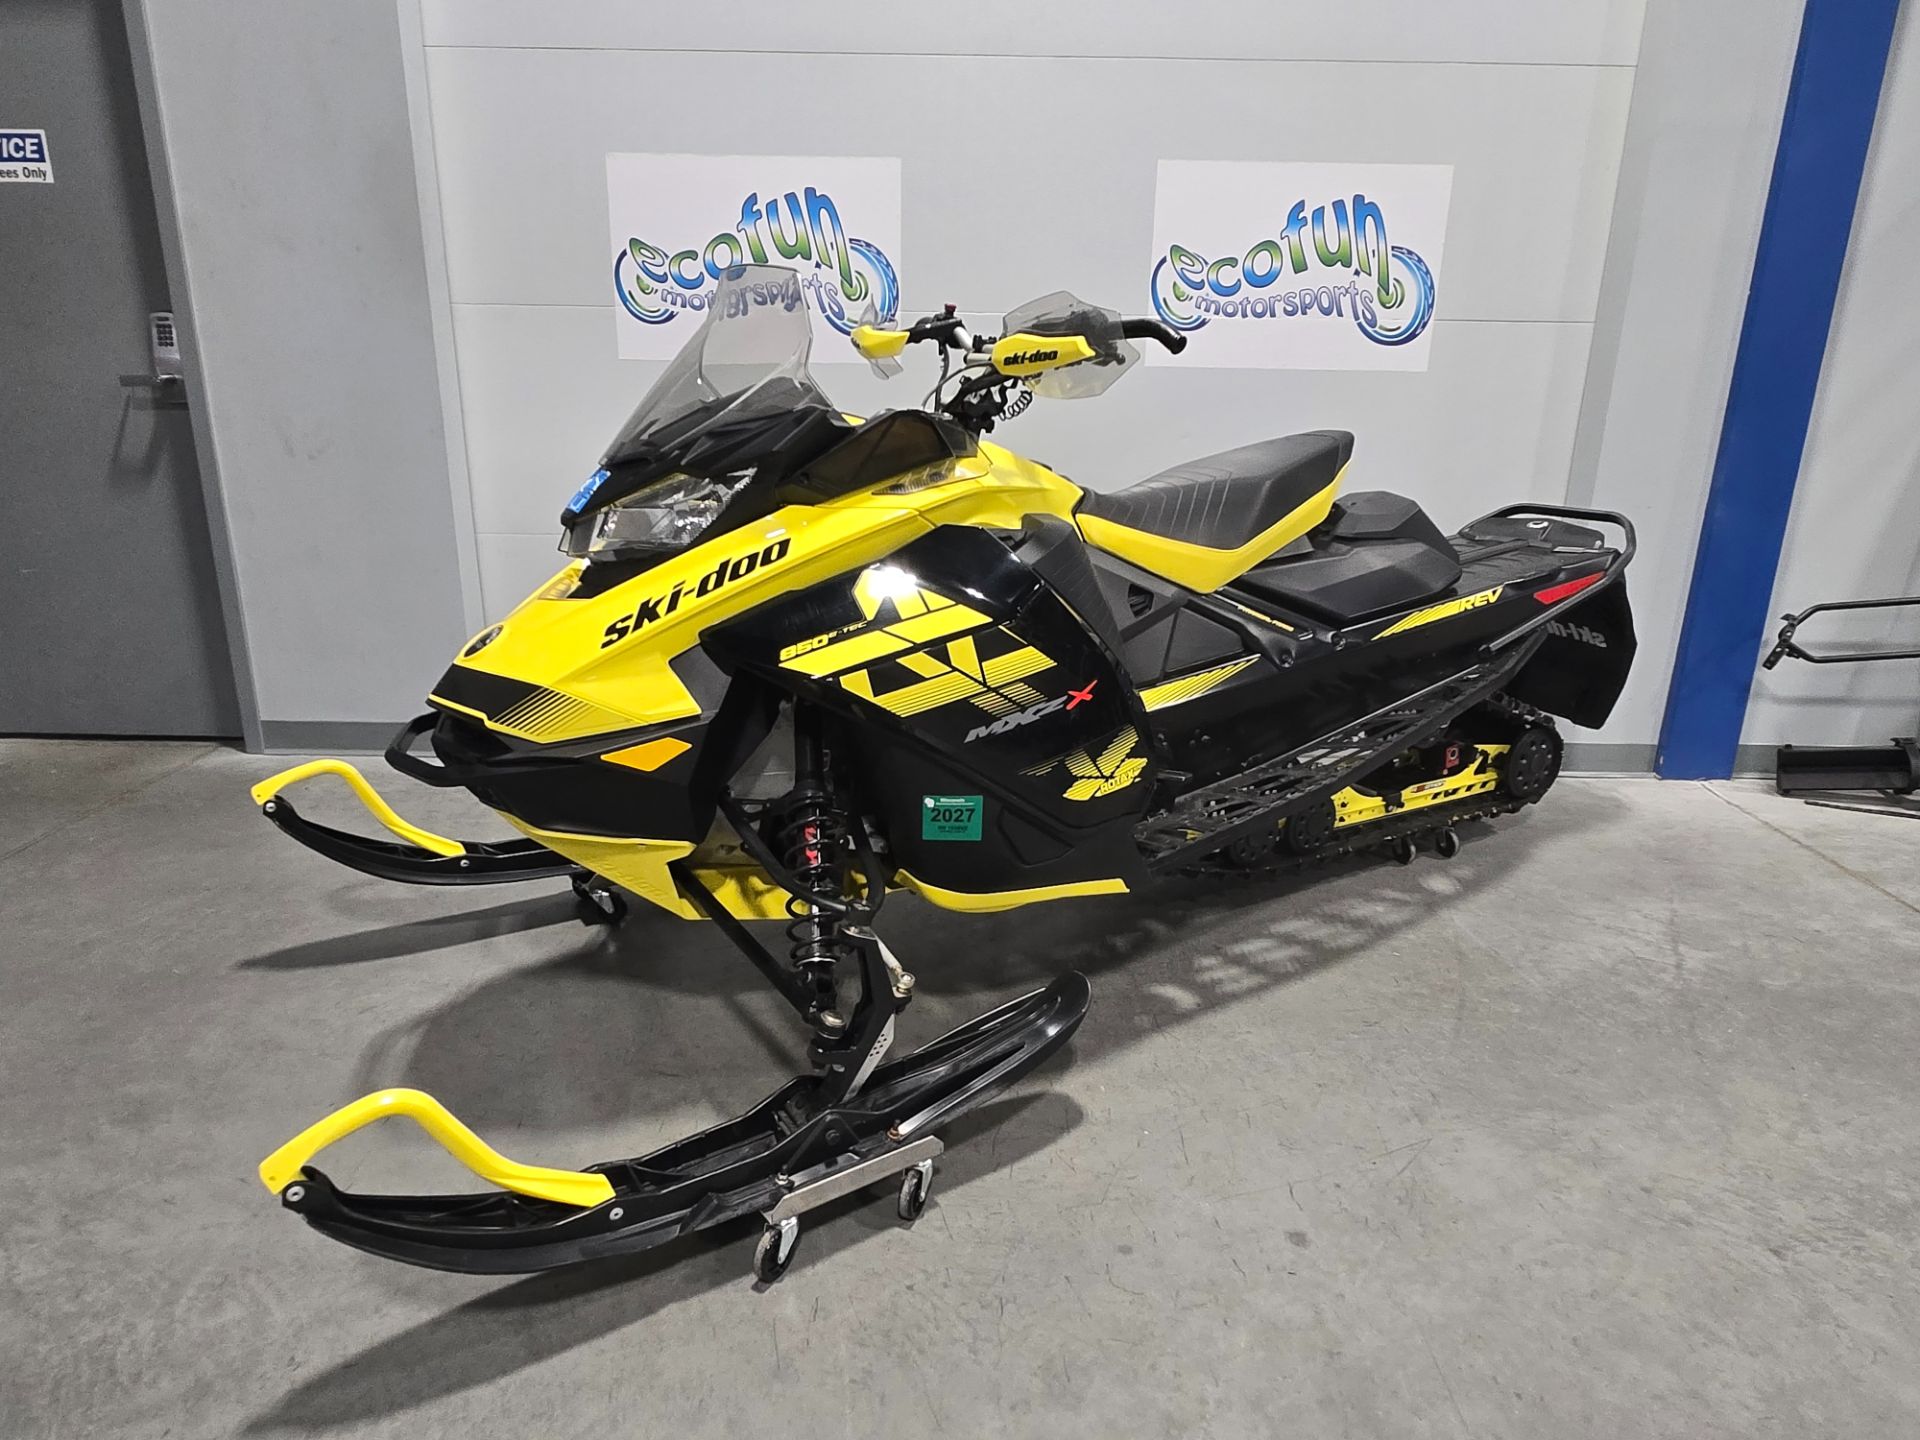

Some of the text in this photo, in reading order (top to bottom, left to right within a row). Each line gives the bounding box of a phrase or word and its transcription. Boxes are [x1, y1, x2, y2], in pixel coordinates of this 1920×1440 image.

[0, 137, 40, 159] ICE
[22, 166, 47, 181] Only
[628, 186, 854, 291] ecofun
[1169, 194, 1390, 297] ecofun
[1194, 280, 1378, 329] motorsports
[1003, 348, 1059, 366] ski-doo
[600, 538, 791, 649] ski-doo
[1458, 584, 1505, 612] REV
[779, 634, 829, 662] 850
[1065, 679, 1099, 711] X
[1100, 768, 1136, 794] ROTAX
[930, 807, 976, 823] 2027
